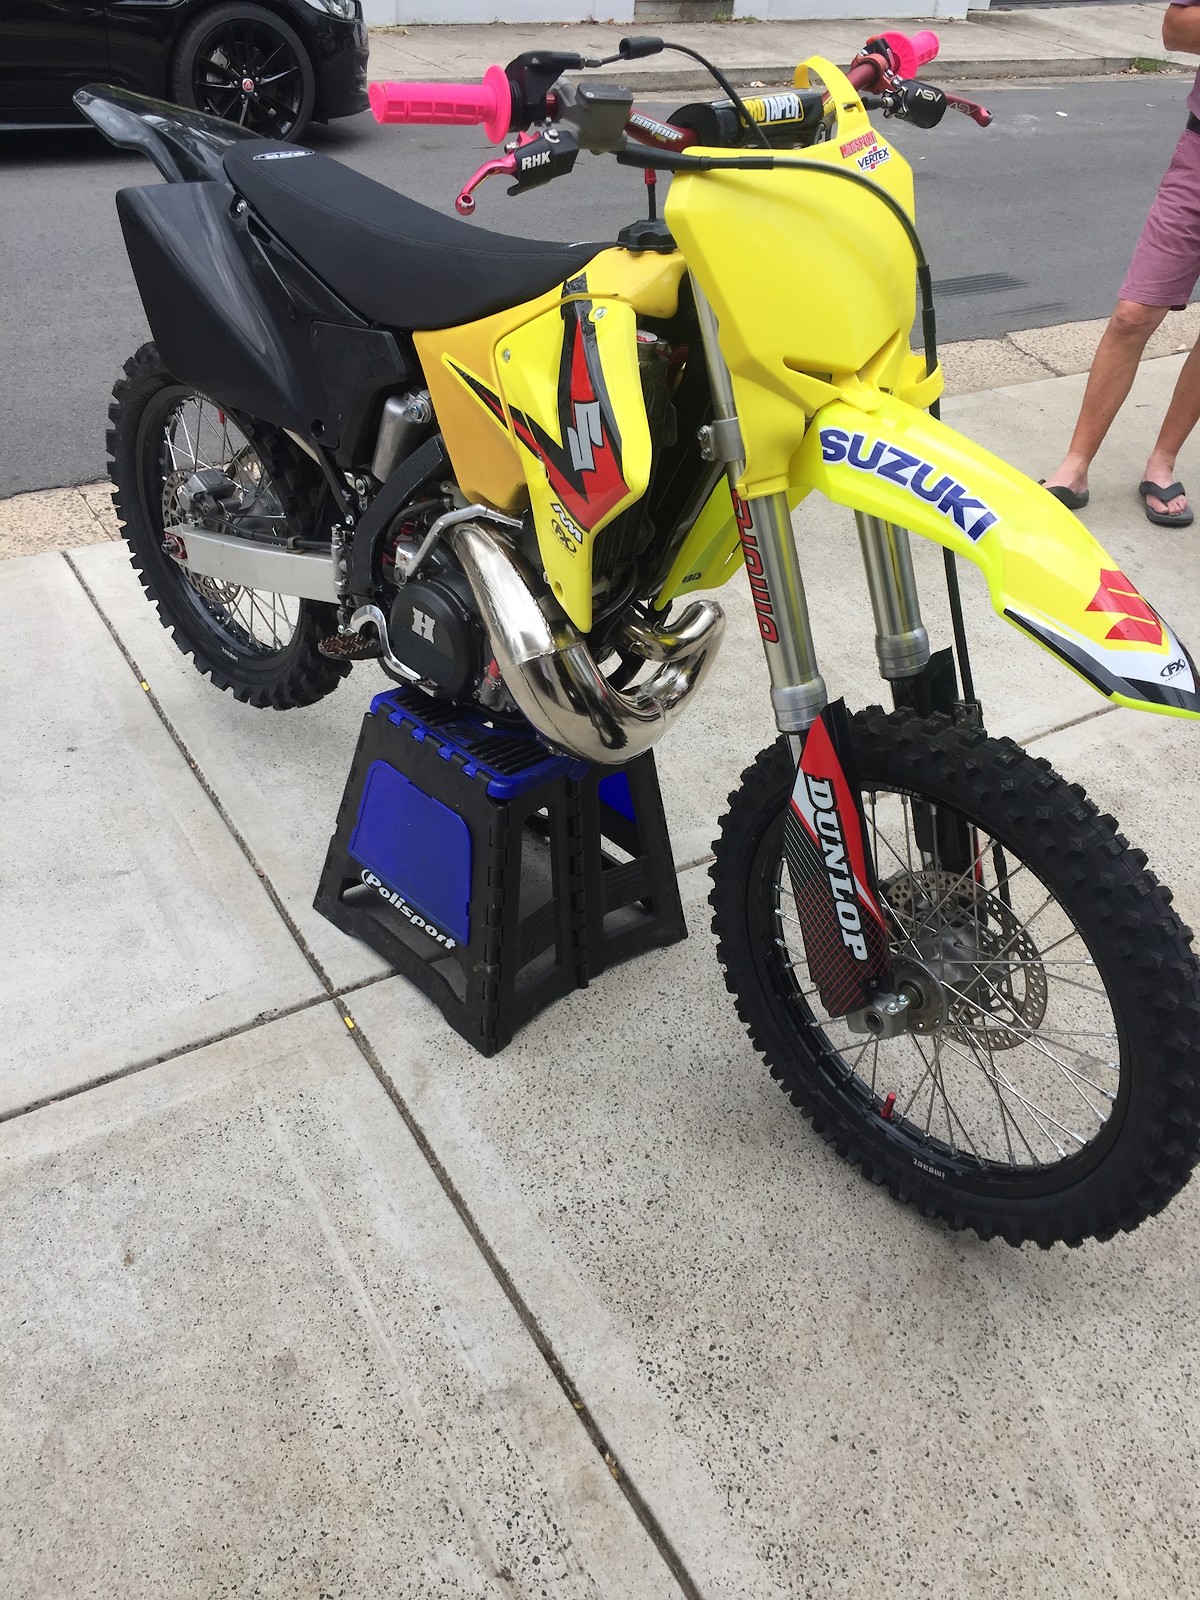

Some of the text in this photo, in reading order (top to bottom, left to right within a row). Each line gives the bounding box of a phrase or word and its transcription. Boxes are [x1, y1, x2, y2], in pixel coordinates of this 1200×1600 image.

[915, 87, 943, 103] ASV
[521, 150, 551, 171] RHK
[857, 147, 890, 168] VERTEX
[820, 429, 998, 541] SUZUKI
[411, 606, 436, 644] H
[806, 774, 869, 962] DUNLOP
[364, 871, 456, 950] Polisport
